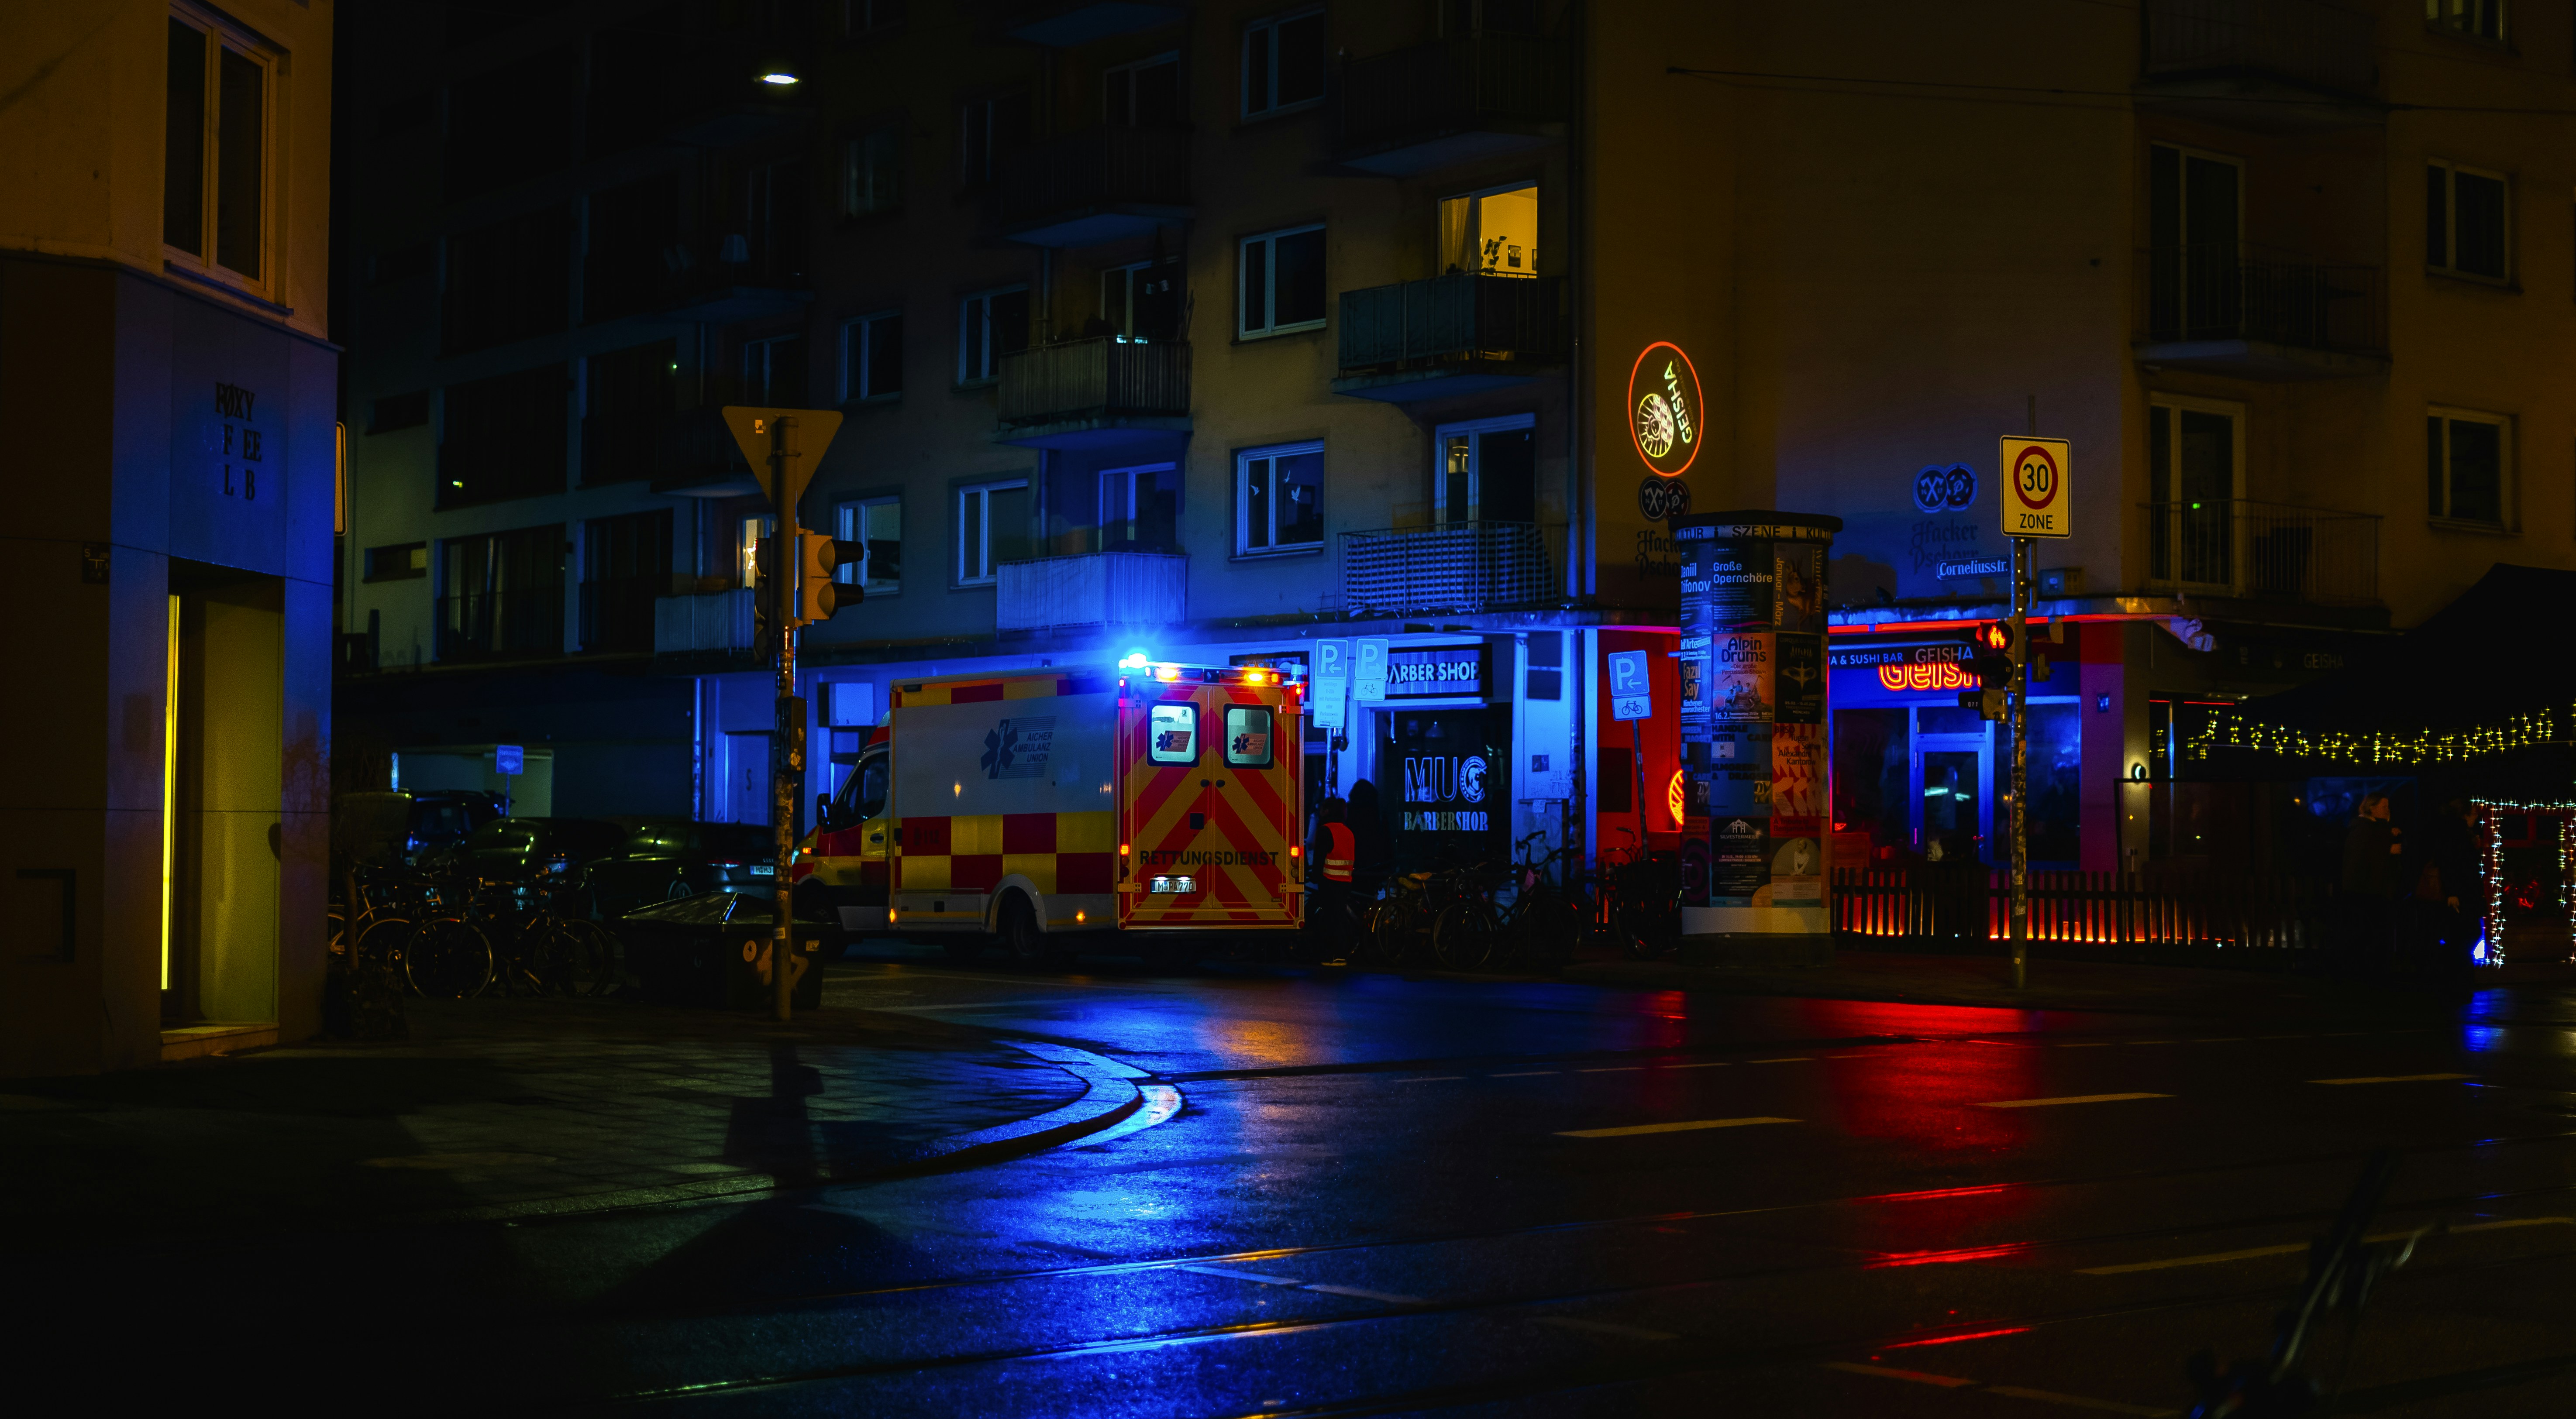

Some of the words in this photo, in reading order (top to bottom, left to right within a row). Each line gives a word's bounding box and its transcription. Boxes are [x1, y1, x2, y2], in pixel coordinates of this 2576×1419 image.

[1664, 361, 1692, 443] GEISHA
[224, 423, 233, 455] F
[224, 464, 234, 496] L
[245, 469, 255, 500] B
[2023, 463, 2049, 492] 30
[2019, 513, 2053, 530] ZONE
[1637, 529, 1681, 553] Hack
[1676, 527, 1704, 541] ULTUR
[1732, 526, 1781, 538] SZENE
[1912, 519, 1978, 546] Hacker
[1713, 561, 1742, 571] Große
[1775, 557, 1785, 592] Januar
[1939, 559, 2008, 576] Corneliusstr.
[1713, 573, 1773, 585] Opernchöre
[1774, 601, 1784, 626] März
[1727, 637, 1761, 651] Alpin
[1321, 645, 1338, 673] P
[1722, 649, 1766, 663] Drums
[1828, 656, 1837, 665] A
[1840, 655, 1847, 665] &
[1850, 653, 1879, 664] SUSHI
[1883, 652, 1903, 663] BAR
[1915, 646, 1973, 663] GEISHA
[2304, 653, 2344, 669] GEISHA
[1438, 661, 1479, 681] SHOP
[1615, 658, 1635, 689] P
[1684, 679, 1699, 701] Say
[1026, 732, 1053, 742] AICHER
[1791, 735, 1809, 744] Tugan
[1012, 742, 1051, 752] AMBULANZ
[1027, 753, 1049, 763] UNION
[1405, 756, 1487, 803] MUC
[1404, 811, 1488, 832] BARBERSHOP
[1140, 851, 1279, 865] RETTUNGSDIENST
[1158, 882, 1163, 891] M
